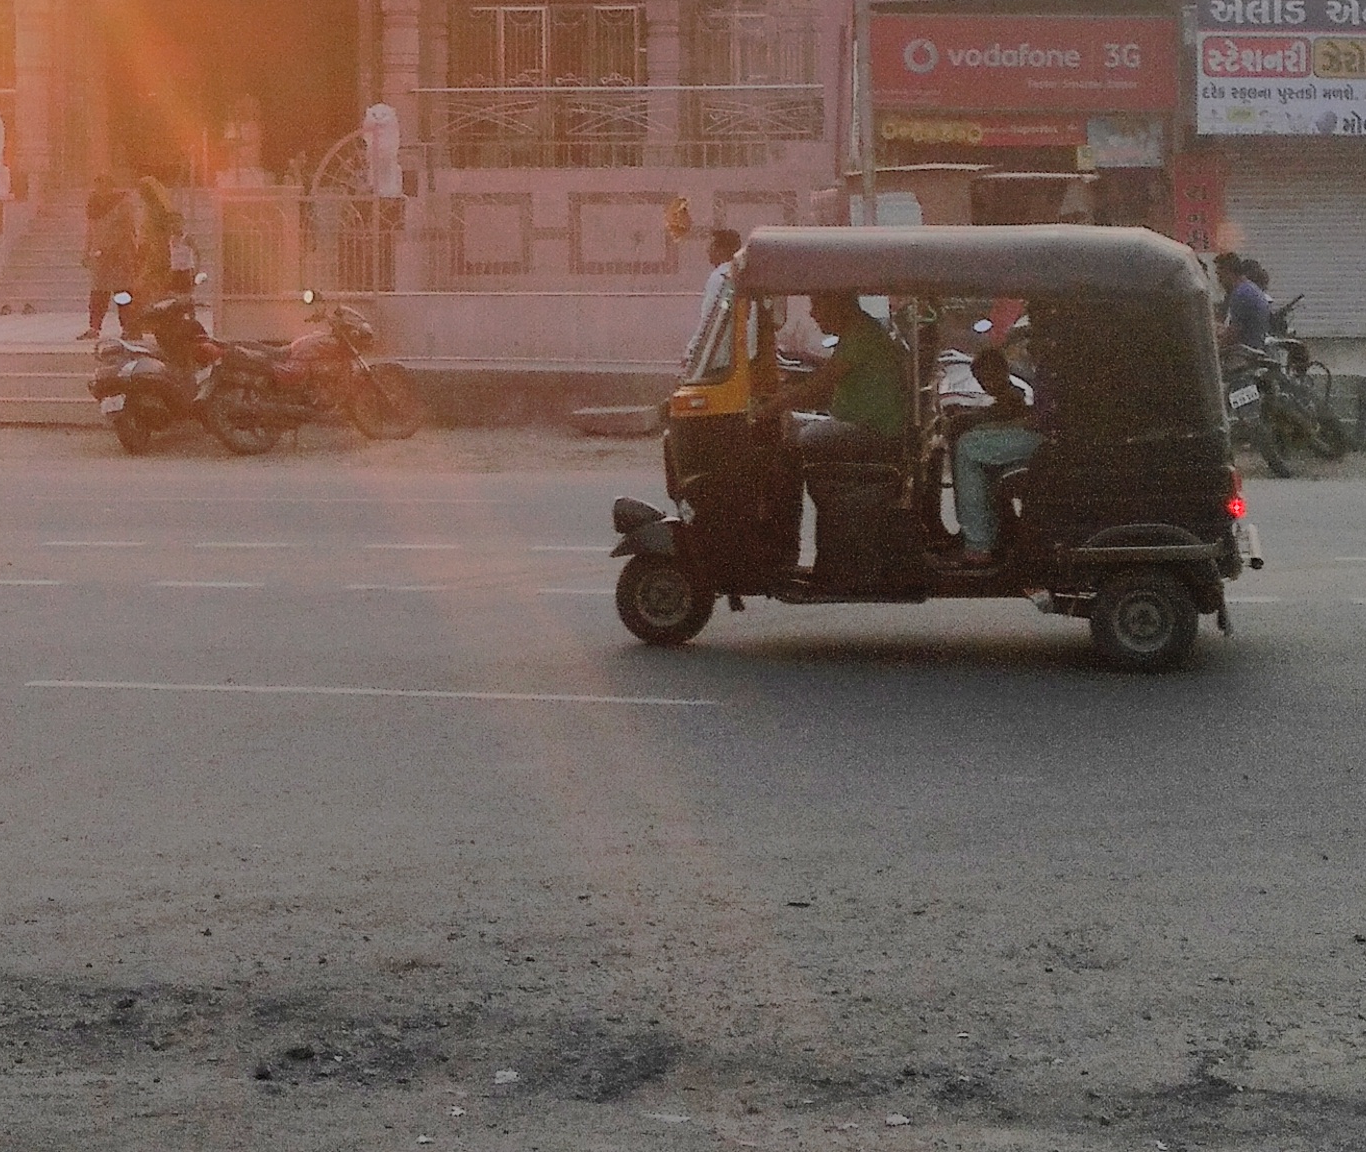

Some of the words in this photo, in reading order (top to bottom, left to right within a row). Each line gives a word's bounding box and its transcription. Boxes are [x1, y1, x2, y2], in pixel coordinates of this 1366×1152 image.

[947, 43, 1082, 69] vodafone
[1103, 42, 1141, 70] 3G
[1207, 39, 1307, 72] સ્ટેશનરી
[1201, 81, 1225, 99] દરેક
[1278, 83, 1317, 105] પુસ્તકો
